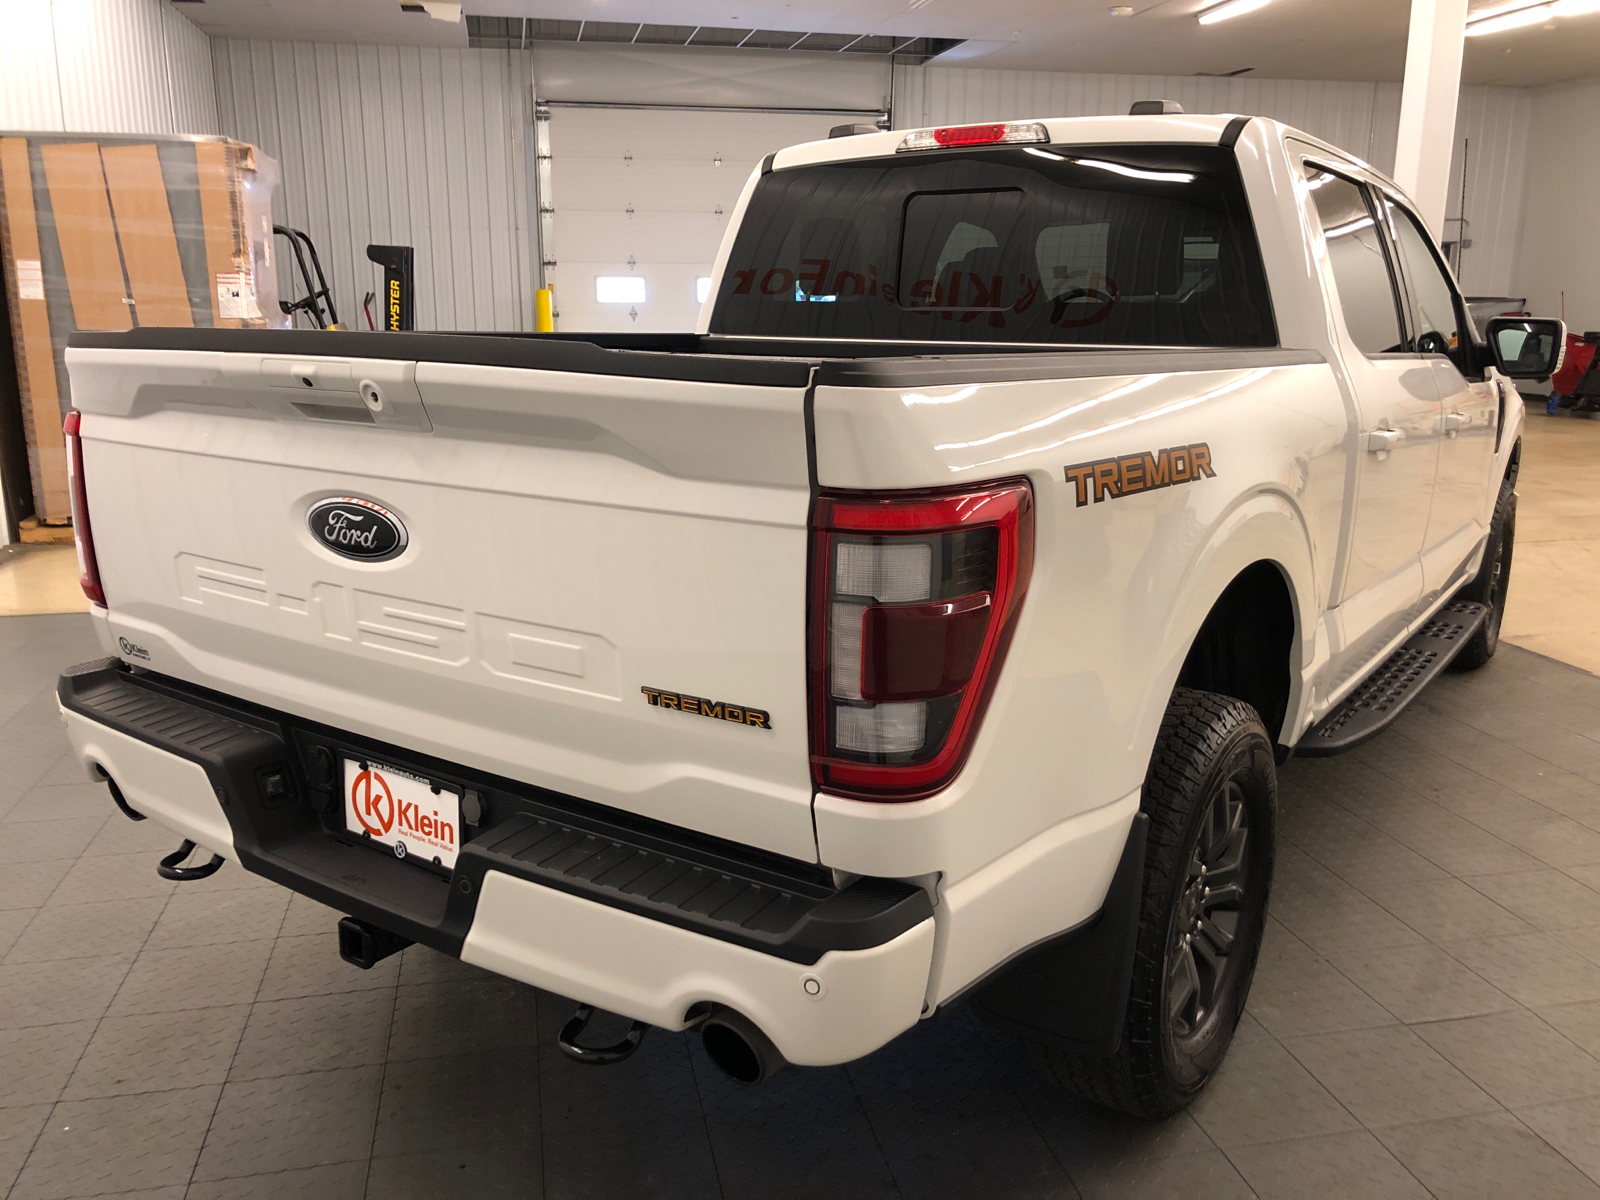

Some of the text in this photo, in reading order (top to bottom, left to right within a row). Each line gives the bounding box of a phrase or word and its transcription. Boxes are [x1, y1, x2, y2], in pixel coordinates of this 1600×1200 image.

[390, 279, 400, 331] HYSTER
[1064, 442, 1217, 508] TREMOR
[324, 509, 378, 549] Ford
[174, 551, 622, 701] F-150
[641, 685, 772, 730] TREMOR
[397, 798, 454, 844] Klein
[398, 828, 409, 837] Real
[427, 838, 439, 847] Real
